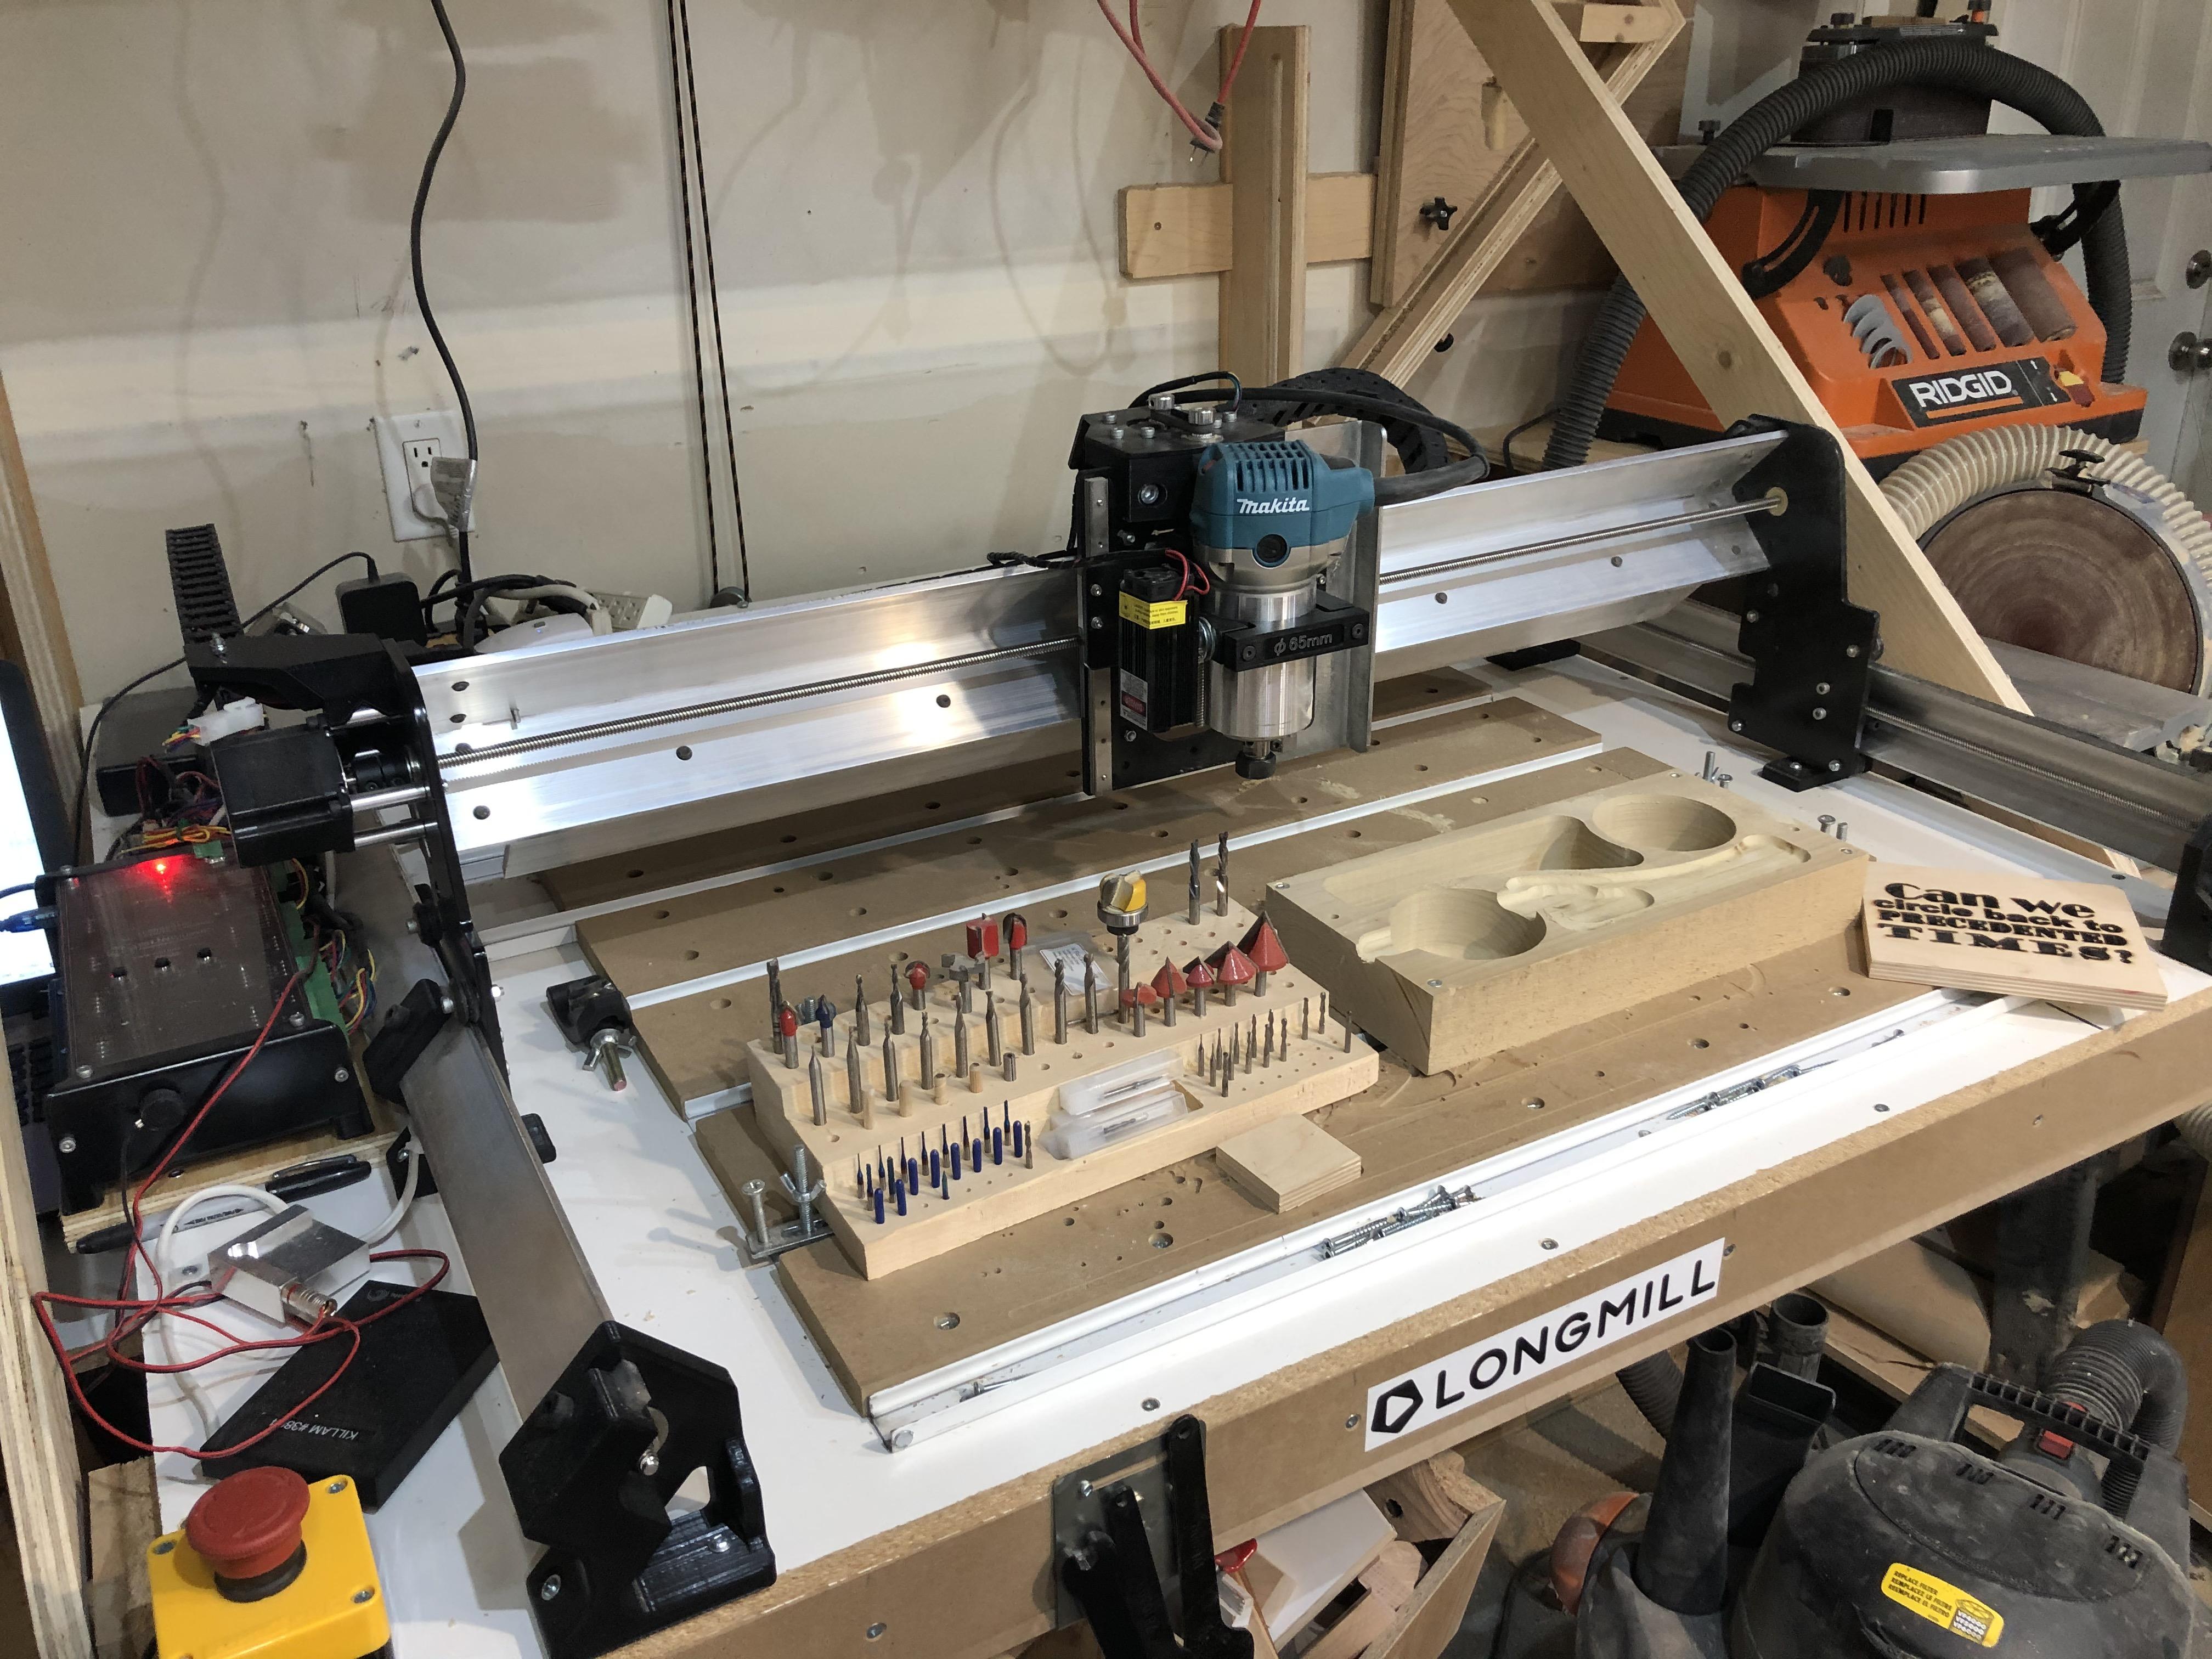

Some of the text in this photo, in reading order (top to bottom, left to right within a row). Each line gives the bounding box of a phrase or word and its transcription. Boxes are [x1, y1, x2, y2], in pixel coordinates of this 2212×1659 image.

[1909, 370, 2012, 407] RIDGID
[1237, 497, 1310, 514] Makita
[1289, 634, 1333, 651] 65mm
[1873, 899, 2123, 933] circle back to
[1885, 883, 2095, 918] Can we
[1878, 909, 2127, 946] PRECEDENTED
[1435, 1260, 1716, 1409] LONGMILL
[308, 1425, 359, 1440] KILLAM
